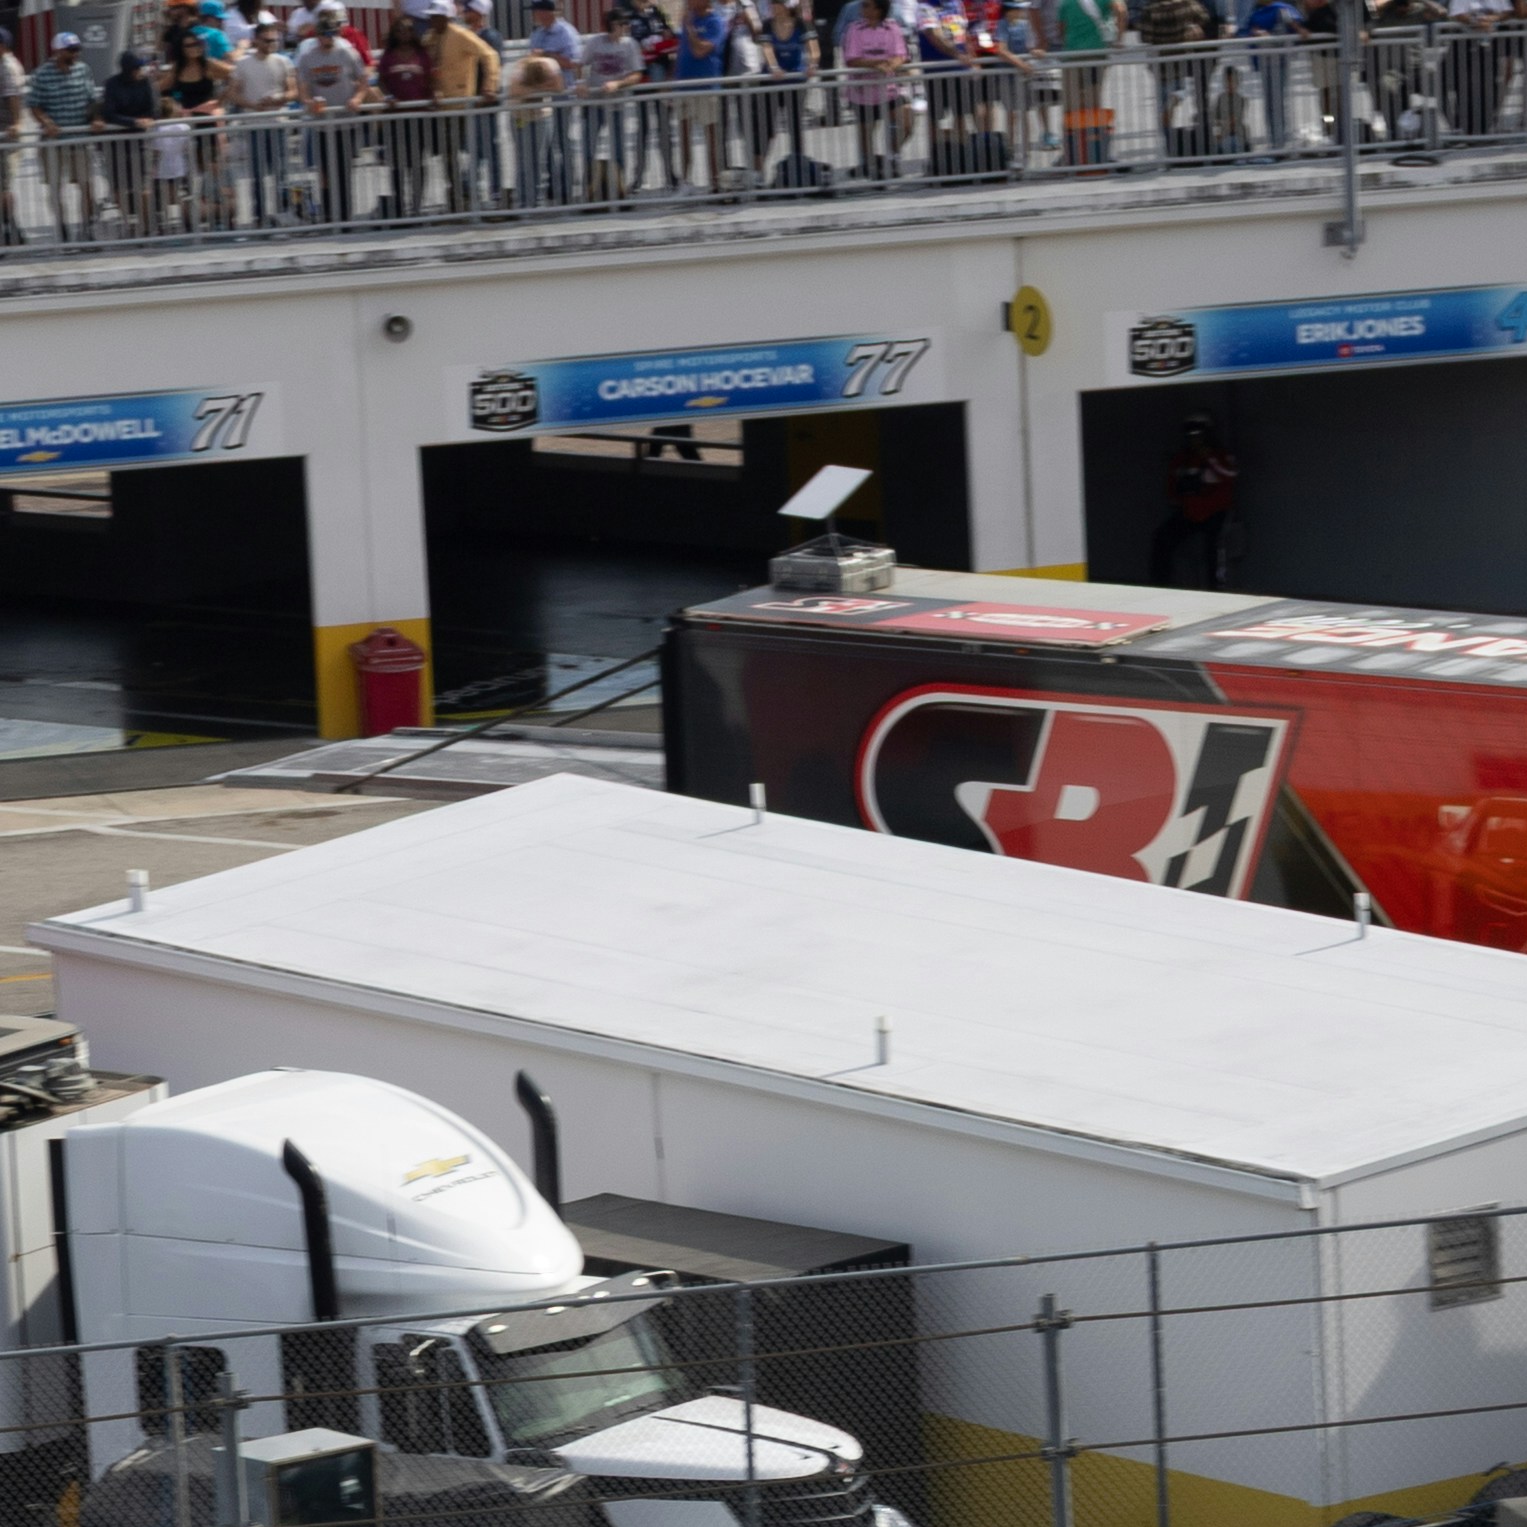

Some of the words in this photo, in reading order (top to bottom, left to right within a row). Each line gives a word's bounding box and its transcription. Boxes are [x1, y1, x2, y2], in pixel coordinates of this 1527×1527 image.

[1024, 303, 1042, 341] 2
[1296, 322, 1340, 344] ERIK
[1341, 315, 1426, 340] JONES
[1133, 336, 1196, 361] 500
[598, 374, 698, 400] CARSON
[700, 364, 815, 391] HOCEVAR
[842, 337, 931, 398] 77
[474, 390, 538, 415] 500
[189, 391, 265, 452] 71
